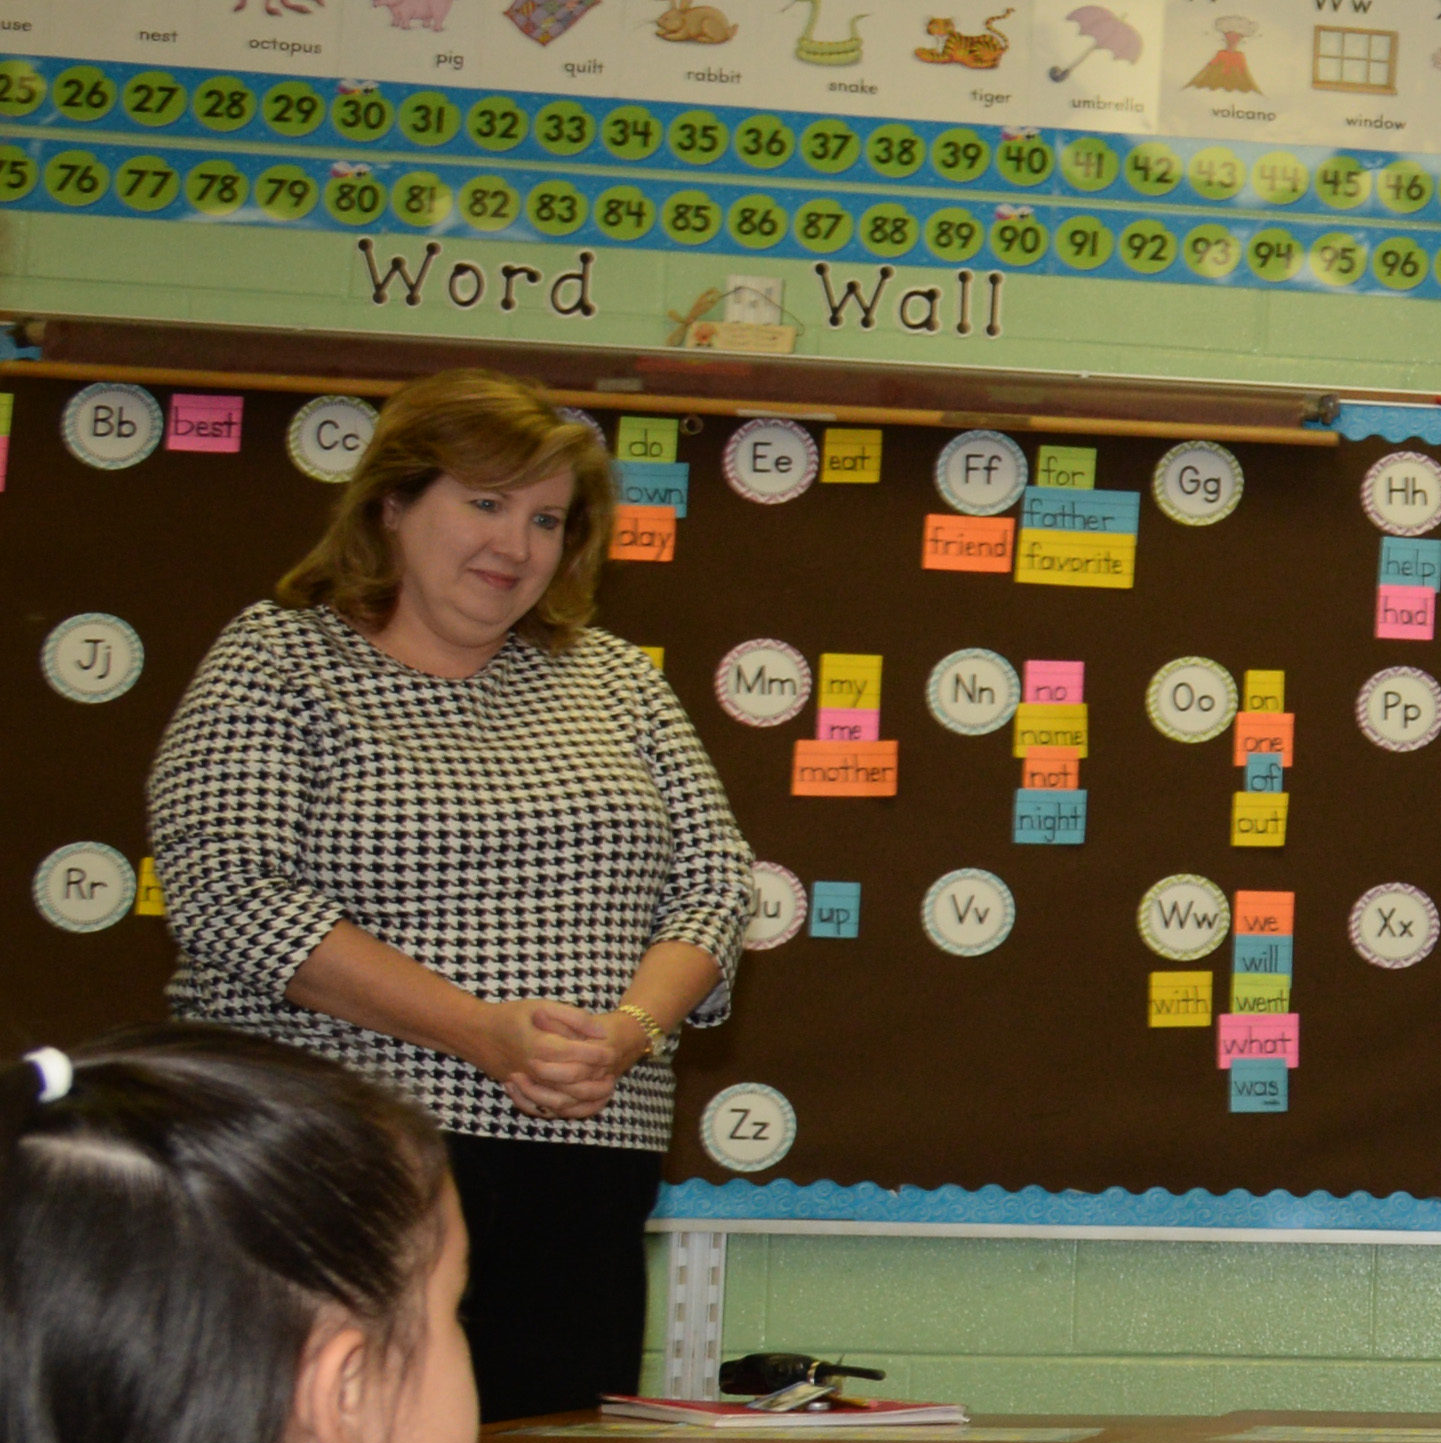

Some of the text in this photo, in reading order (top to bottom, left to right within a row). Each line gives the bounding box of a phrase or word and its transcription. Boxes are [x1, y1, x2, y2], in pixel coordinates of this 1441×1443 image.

[139, 29, 178, 44] nest
[248, 37, 323, 56] octopus
[435, 52, 464, 71] pig
[563, 59, 605, 76] quilt
[686, 67, 743, 85] rabbit
[828, 80, 878, 95] snake
[970, 88, 1012, 109] tiger
[1071, 96, 1145, 114] umbrella
[1211, 105, 1277, 122] volcano
[63, 78, 108, 109] 26
[132, 84, 178, 113] 27
[203, 89, 249, 119] 28
[272, 95, 317, 124] 29
[341, 99, 386, 129] 30
[412, 105, 444, 134] 31
[476, 109, 519, 139] 32
[544, 114, 587, 143] 33
[608, 118, 653, 148] 34
[677, 123, 719, 152] 35
[743, 128, 786, 157] 36
[811, 132, 853, 160] 37
[875, 137, 918, 166] 38
[940, 141, 983, 170] 39
[1005, 145, 1048, 174] 40
[1321, 168, 1361, 198] 45
[1345, 115, 1407, 131] window
[357, 237, 1005, 337] Word Wall
[92, 404, 138, 439] Bb
[174, 406, 238, 439] best
[315, 419, 361, 452] Cc
[629, 428, 664, 458] do
[752, 441, 793, 473] Ee
[828, 446, 870, 471] eat
[964, 453, 1002, 485] Ff
[1041, 456, 1085, 486] for
[1178, 465, 1222, 503] Gg
[1387, 476, 1428, 506] Hh
[1022, 498, 1115, 531] father
[618, 517, 673, 560] day
[929, 526, 1008, 558] friend
[1024, 541, 1123, 574] favorite
[1385, 547, 1437, 587] help
[1383, 595, 1428, 626] had
[76, 638, 113, 680] Jj
[735, 663, 797, 696] Mm
[829, 677, 868, 708] my
[952, 672, 996, 705] Nn
[1035, 682, 1068, 702] no
[1172, 681, 1215, 712] Oo
[1249, 693, 1280, 710] on
[1382, 690, 1422, 729] Pp
[829, 722, 862, 741] me
[1019, 727, 1085, 747] name
[1244, 735, 1284, 752] one
[799, 755, 895, 783] mother
[1028, 764, 1074, 788] not
[1250, 762, 1281, 792] of
[1019, 802, 1081, 842] night
[1236, 810, 1283, 834] out
[63, 866, 108, 901] Rr
[817, 906, 851, 935] up
[950, 893, 990, 925] Vv
[1157, 899, 1219, 930] Ww
[1243, 913, 1279, 932] we
[1376, 906, 1415, 939] Xx
[1241, 944, 1279, 973] will
[1152, 985, 1209, 1015] with
[1235, 988, 1289, 1013] went
[1223, 1025, 1292, 1056] what
[1233, 1076, 1280, 1097] was
[728, 1108, 771, 1142] Zz
